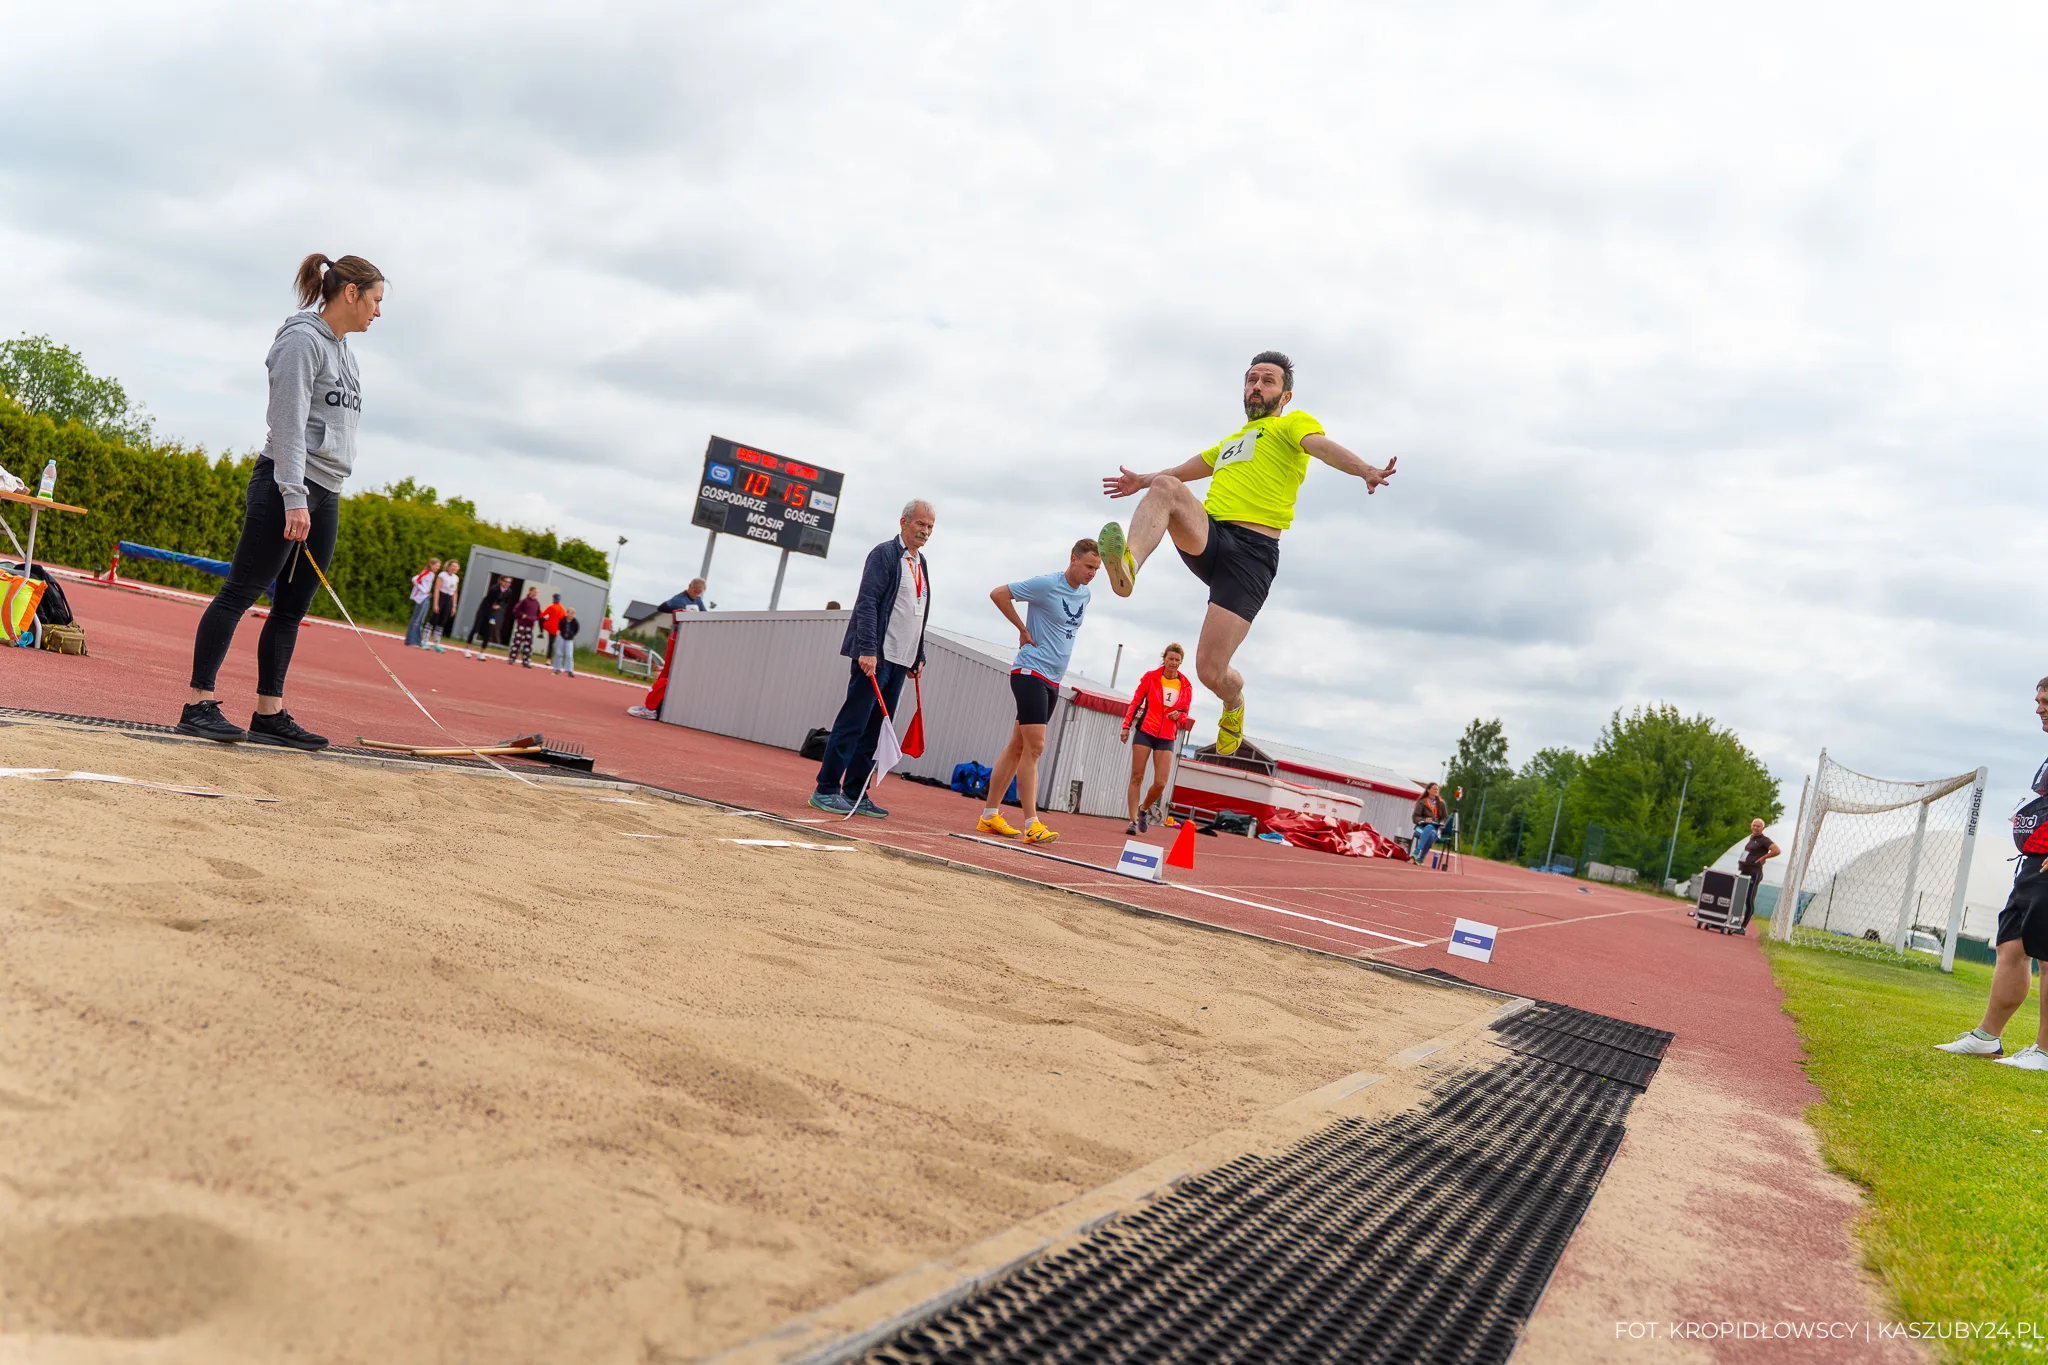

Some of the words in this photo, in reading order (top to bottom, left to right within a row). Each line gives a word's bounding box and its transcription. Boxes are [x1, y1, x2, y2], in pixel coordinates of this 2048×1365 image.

[1221, 439, 1245, 460] 61
[701, 485, 767, 512] GOSPODARZE
[744, 472, 771, 497] 10
[783, 483, 808, 507] 15
[746, 512, 785, 531] MOSIR
[784, 508, 820, 526] GOŚCIE
[747, 526, 778, 542] REDA
[1165, 692, 1172, 702] 1
